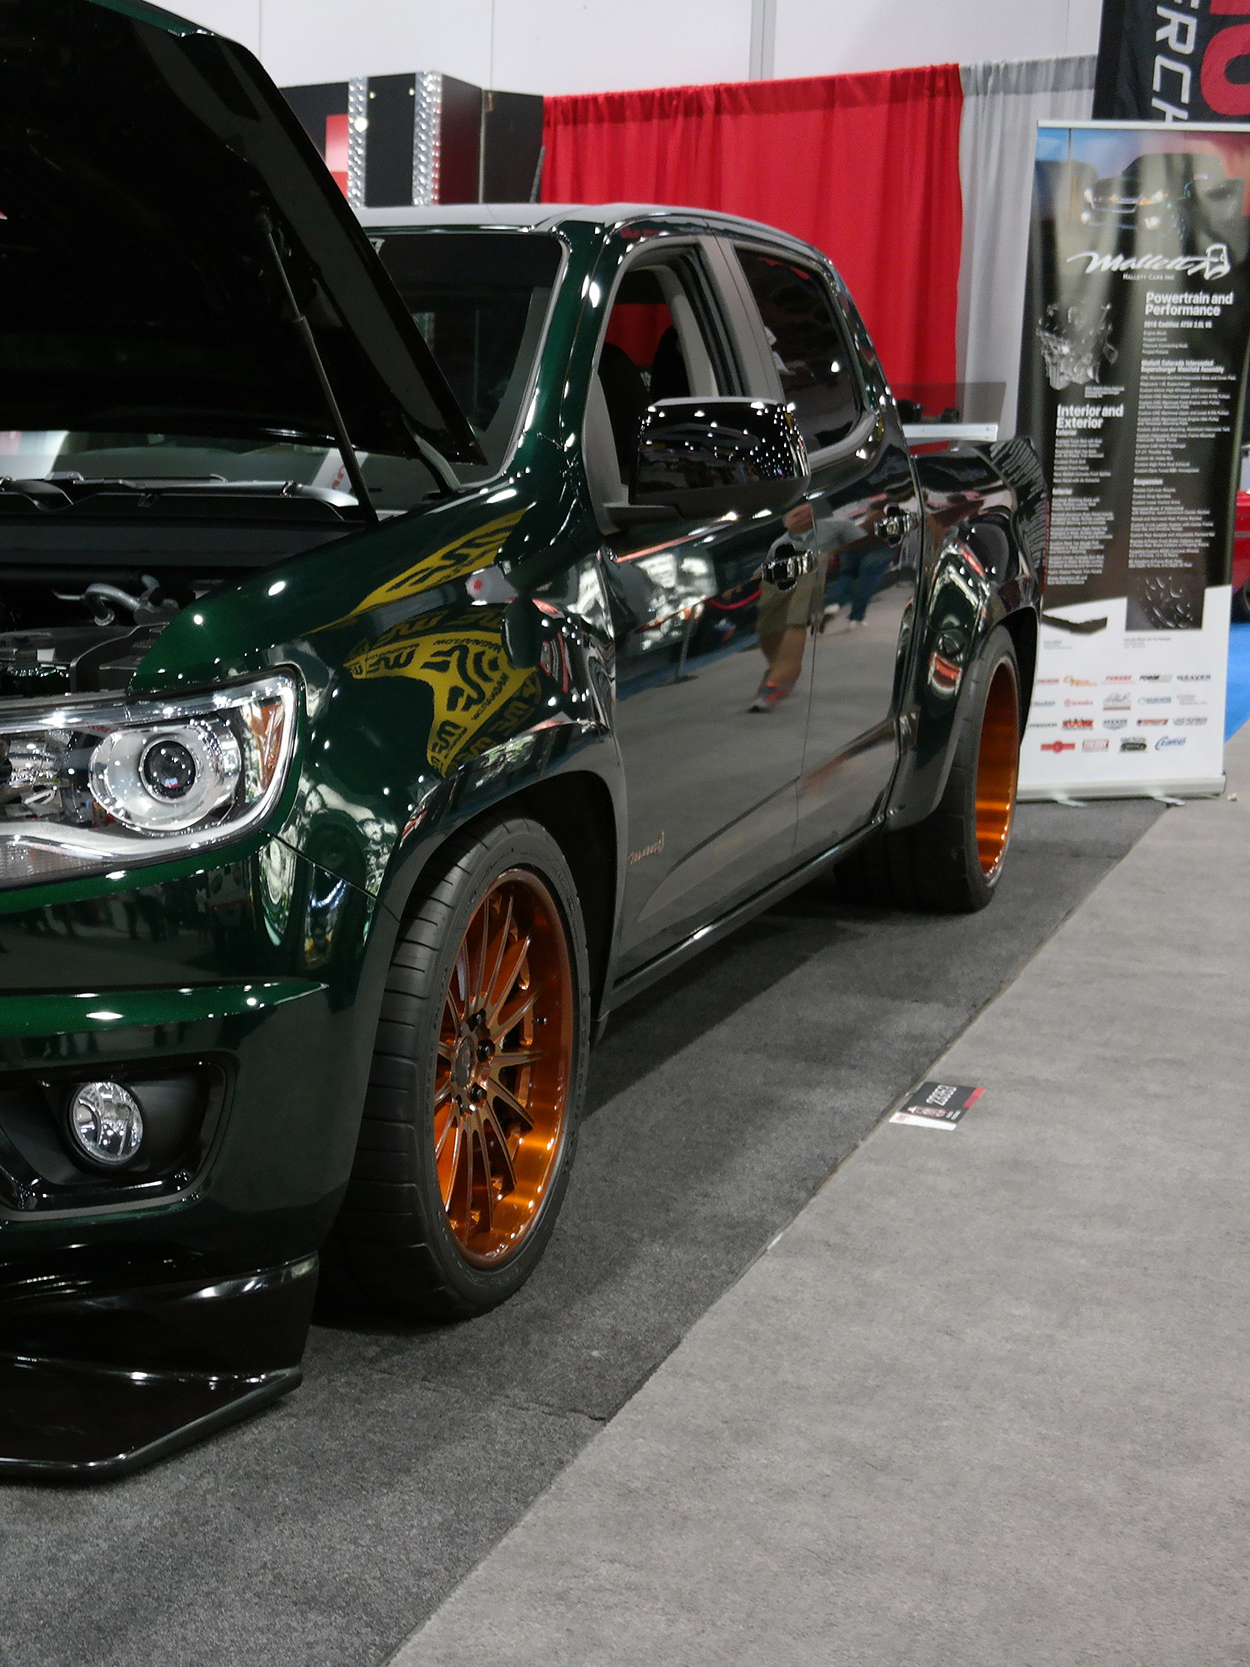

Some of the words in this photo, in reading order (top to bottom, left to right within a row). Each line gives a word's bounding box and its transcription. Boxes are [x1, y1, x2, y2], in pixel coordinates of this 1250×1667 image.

[1066, 250, 1216, 276] Mallett
[1146, 291, 1209, 305] Powertrain
[1211, 291, 1233, 305] and
[1145, 304, 1222, 317] Performance
[1057, 403, 1101, 417] Interior
[1101, 403, 1124, 417] and
[1057, 416, 1104, 428] Exterior
